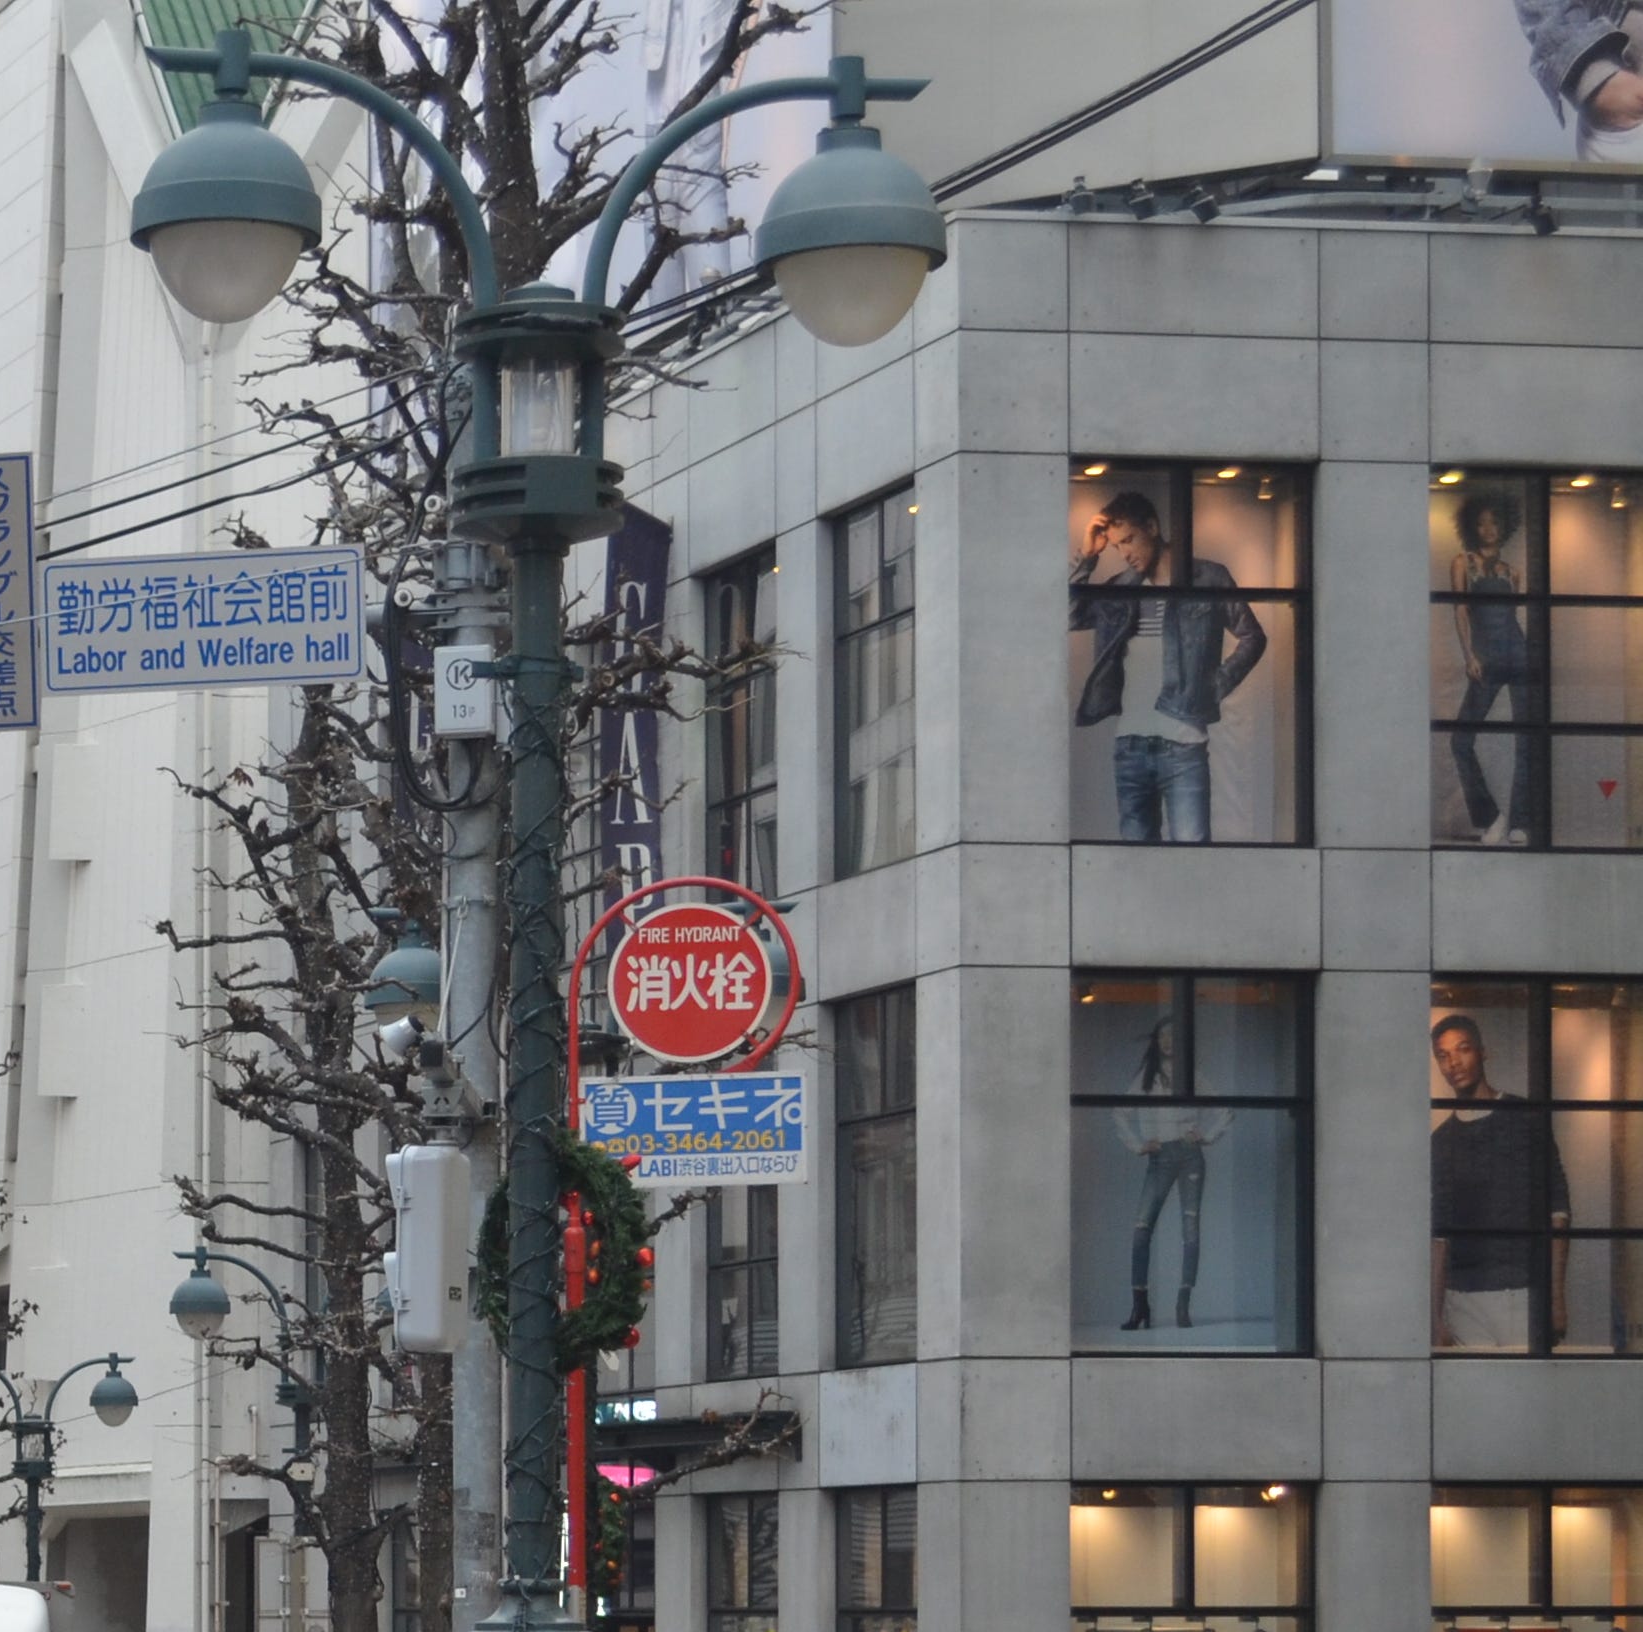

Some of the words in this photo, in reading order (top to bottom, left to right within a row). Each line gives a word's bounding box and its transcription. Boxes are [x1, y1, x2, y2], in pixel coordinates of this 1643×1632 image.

[57, 564, 348, 636] 勤労福祉会館前
[57, 645, 127, 674] Labor
[140, 641, 185, 671] and
[197, 637, 294, 667] Welfare
[305, 632, 350, 662] hall
[638, 927, 670, 944] FIRE
[675, 925, 740, 943] HYDRANT
[626, 952, 756, 1012] 消火栓
[643, 1078, 801, 1131] セキネ
[627, 1129, 787, 1154] 03-3464-2061
